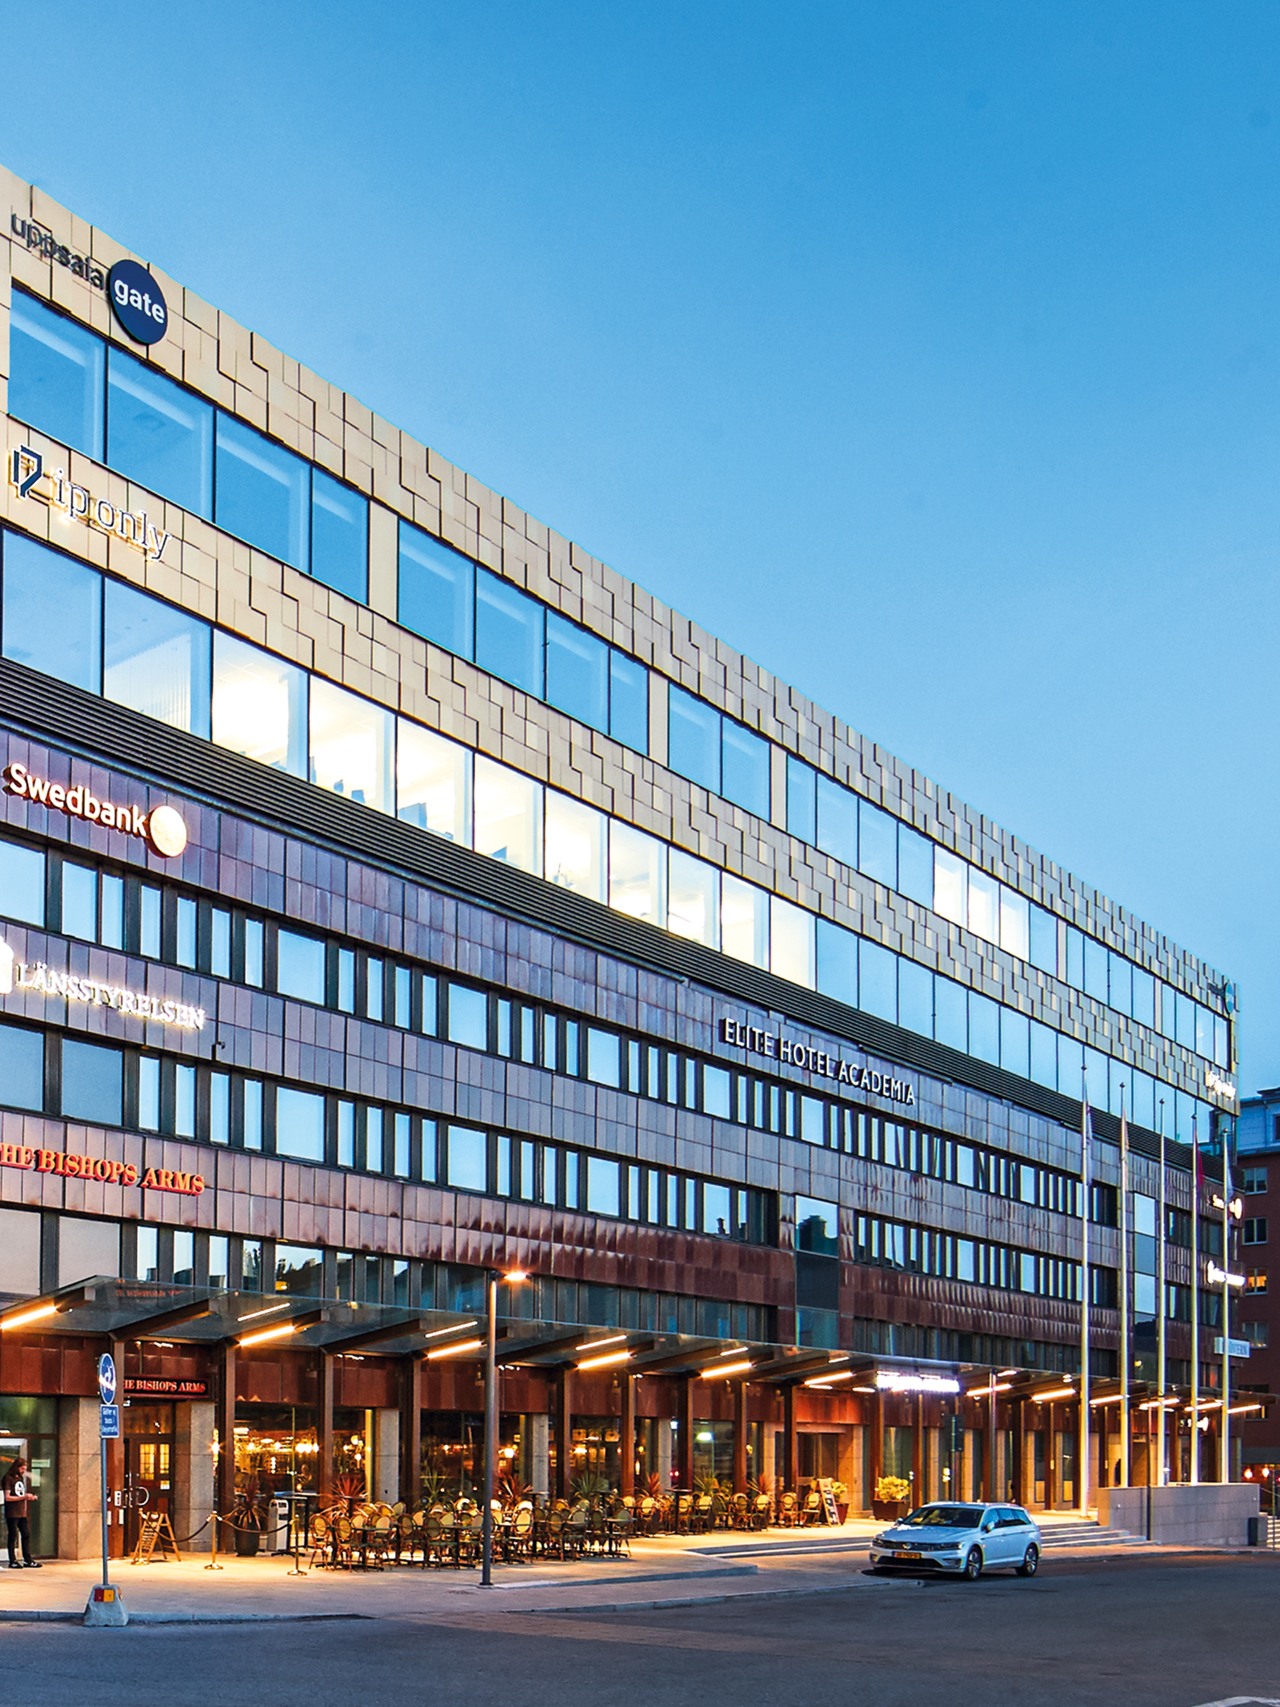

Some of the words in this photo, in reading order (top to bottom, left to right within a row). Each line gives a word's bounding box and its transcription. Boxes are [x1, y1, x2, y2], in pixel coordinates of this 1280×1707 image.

[114, 279, 165, 324] gate
[3, 762, 147, 838] Swedbank
[16, 961, 206, 1030] LÄNSSTYRELSEN
[724, 1017, 774, 1057] ELITE
[780, 1037, 834, 1078] HOTEL
[838, 1060, 916, 1106] ACADEMIA
[35, 1149, 138, 1186] BISHOPS
[140, 1166, 205, 1196] ARMS
[123, 1379, 135, 1390] HE
[136, 1380, 177, 1392] BISHOPS
[178, 1382, 206, 1393] ARMS
